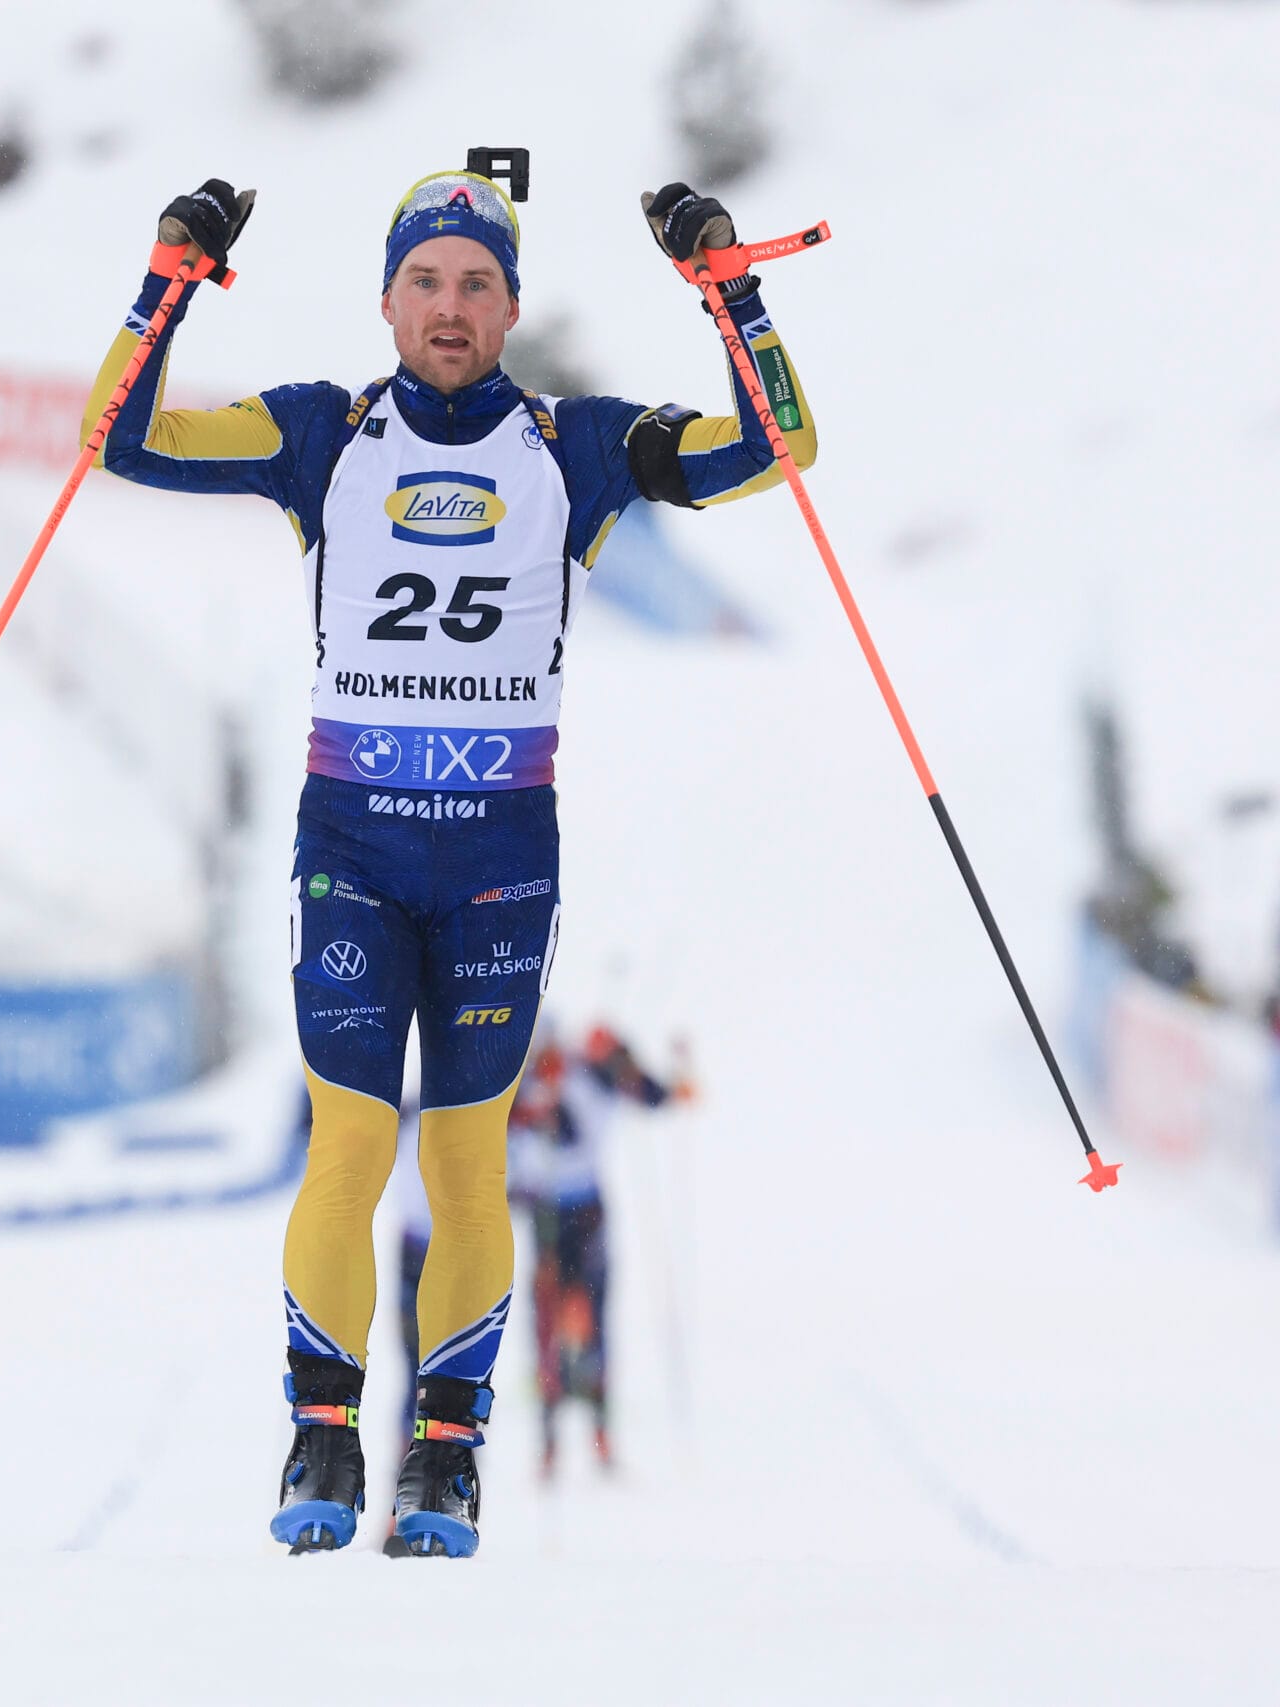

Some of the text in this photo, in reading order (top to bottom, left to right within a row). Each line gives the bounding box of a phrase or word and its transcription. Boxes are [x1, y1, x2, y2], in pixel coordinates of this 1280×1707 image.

[750, 238, 801, 258] ONE/WAY
[775, 382, 784, 402] Dina
[345, 394, 370, 427] ATG
[533, 410, 558, 440] ATG
[367, 572, 512, 643] 25
[334, 671, 537, 701] HOLMENKOLLEN
[360, 731, 395, 747] BMW
[411, 733, 423, 780] THE NEW
[424, 734, 514, 782] iX2
[368, 793, 494, 820] monitor
[310, 880, 328, 890] dina
[335, 879, 353, 891] Dina
[454, 955, 542, 978] SVEASKOG
[311, 1006, 387, 1019] SWEDEMOUNT
[455, 1007, 512, 1025] ATG
[299, 1412, 332, 1420] SALOMON
[440, 1429, 475, 1443] SALOMON
